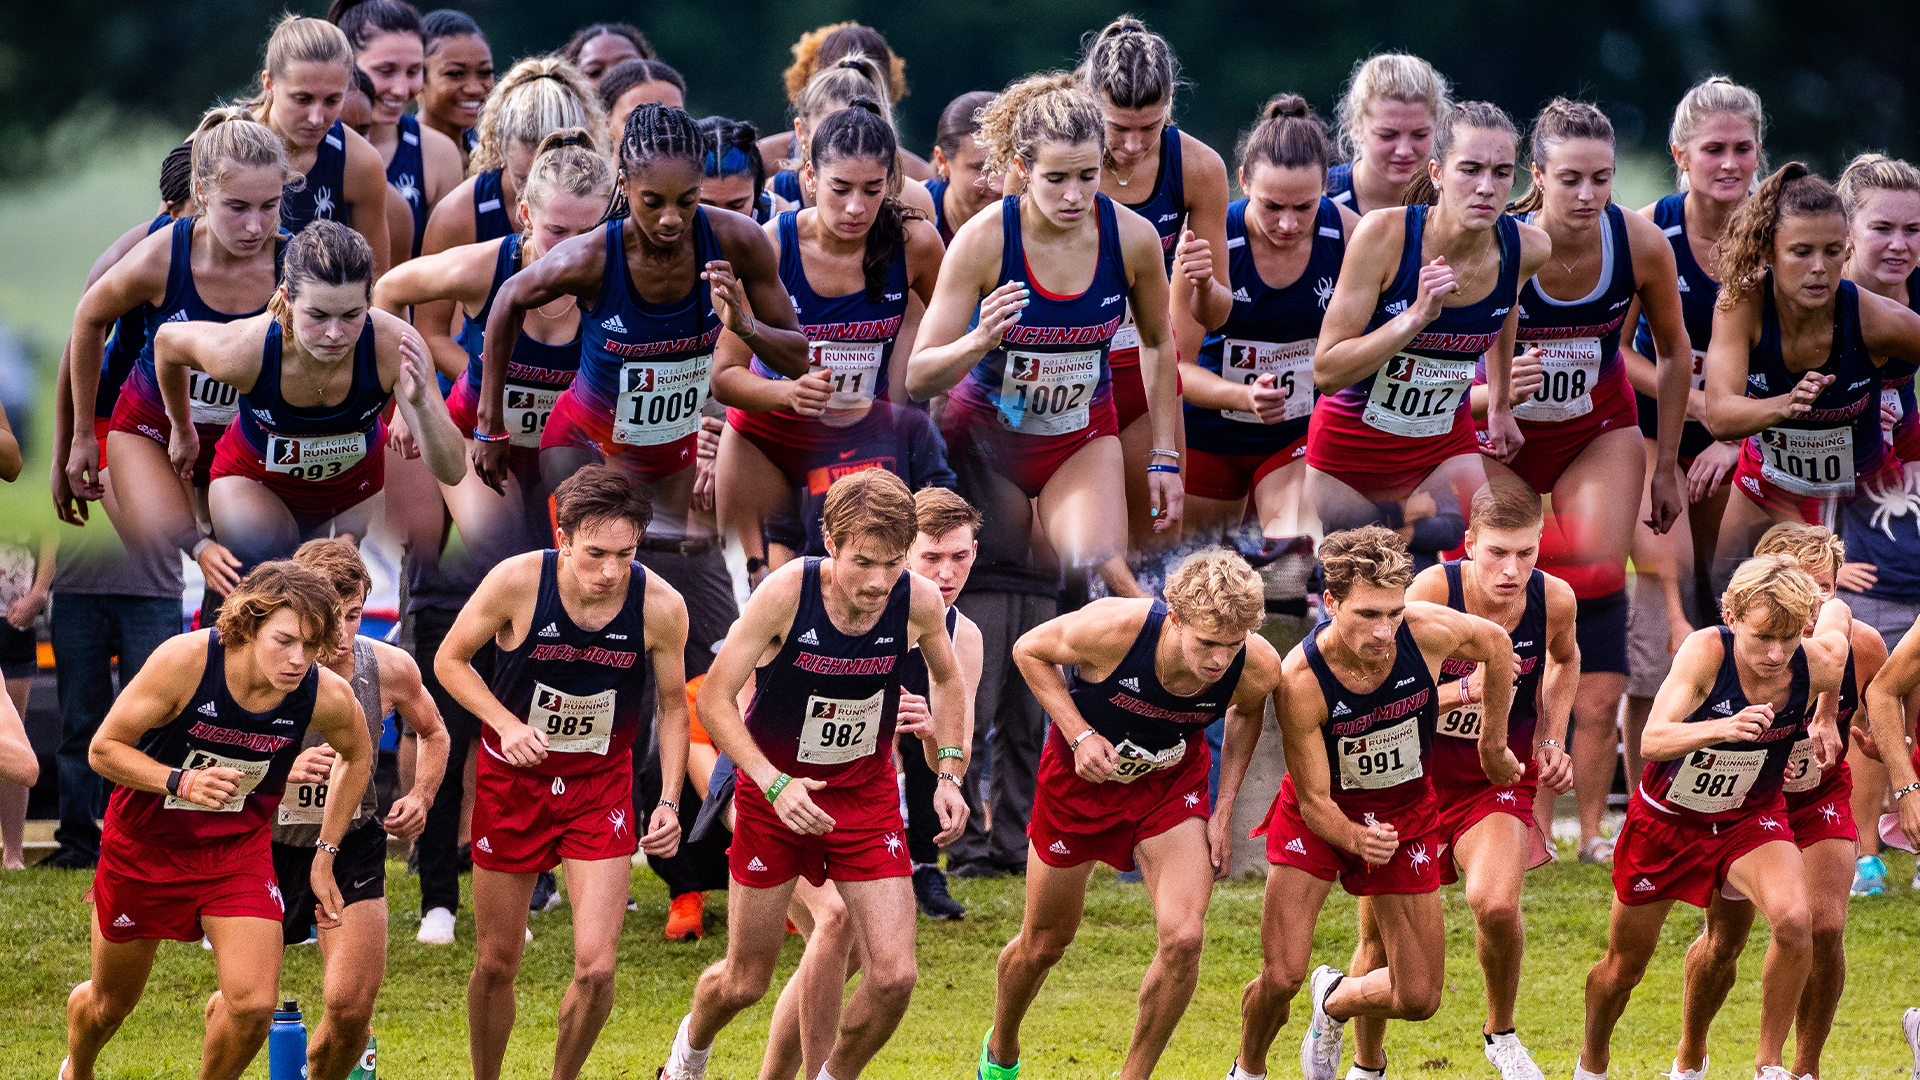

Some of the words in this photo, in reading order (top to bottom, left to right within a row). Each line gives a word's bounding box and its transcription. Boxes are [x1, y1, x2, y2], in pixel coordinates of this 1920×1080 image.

[1158, 212, 1178, 223] A10
[1101, 294, 1121, 307] A10
[1491, 307, 1509, 317] A10
[601, 322, 628, 334] adidas
[800, 315, 901, 341] CHMOND
[1406, 329, 1500, 353] CHMON
[824, 352, 875, 362] RUNNING
[1043, 355, 1095, 367] COLLEGIATE
[1259, 348, 1310, 364] RUNNING
[1541, 349, 1595, 360] RUNNING
[657, 360, 707, 376] COLLEGIATE
[1042, 361, 1093, 376] RUNNING
[1418, 360, 1469, 371] COLLEGIATE
[657, 367, 707, 385] RUNNING
[1041, 373, 1094, 383] ASSOCIATION
[1416, 367, 1468, 380] RUNNING
[189, 371, 237, 407] 100
[656, 377, 706, 393] ASSOCIATION
[833, 372, 863, 393] 11
[1533, 369, 1586, 403] 008
[1748, 374, 1769, 392] adidas
[628, 387, 698, 426] 1009
[1011, 383, 1087, 416] 1002
[1381, 382, 1454, 418] 1012
[1790, 431, 1844, 440] COLLEGIATE
[1790, 436, 1846, 449] RUNNING
[303, 437, 359, 450] COLLEGIATE
[1790, 446, 1846, 455] ASSOCIATION
[303, 444, 359, 458] RUNNING
[1770, 447, 1841, 483] 1010
[1740, 476, 1765, 498] adidas
[538, 629, 560, 638] adidas
[797, 636, 820, 646] adidas
[874, 637, 894, 645] A10
[1514, 640, 1533, 649] A10
[528, 644, 637, 669] RICHMOND
[793, 650, 898, 676] RICHMOND
[1119, 679, 1141, 693] adidas
[1394, 676, 1416, 689] A10
[197, 707, 218, 718] adidas
[563, 700, 610, 711] RUNNING
[838, 702, 880, 716] RUNNING
[1109, 692, 1216, 724] RICHMOND
[1331, 687, 1430, 737] RICHMOND
[1712, 705, 1734, 716] adidas
[272, 718, 295, 726] A10
[546, 714, 595, 736] 985
[1443, 710, 1481, 736] 98
[820, 721, 867, 747] 982
[1368, 728, 1413, 747] RUNNING
[1358, 747, 1404, 776] 991
[1715, 760, 1759, 768] RUNNING
[1691, 772, 1740, 798] 981
[299, 785, 328, 808] 98
